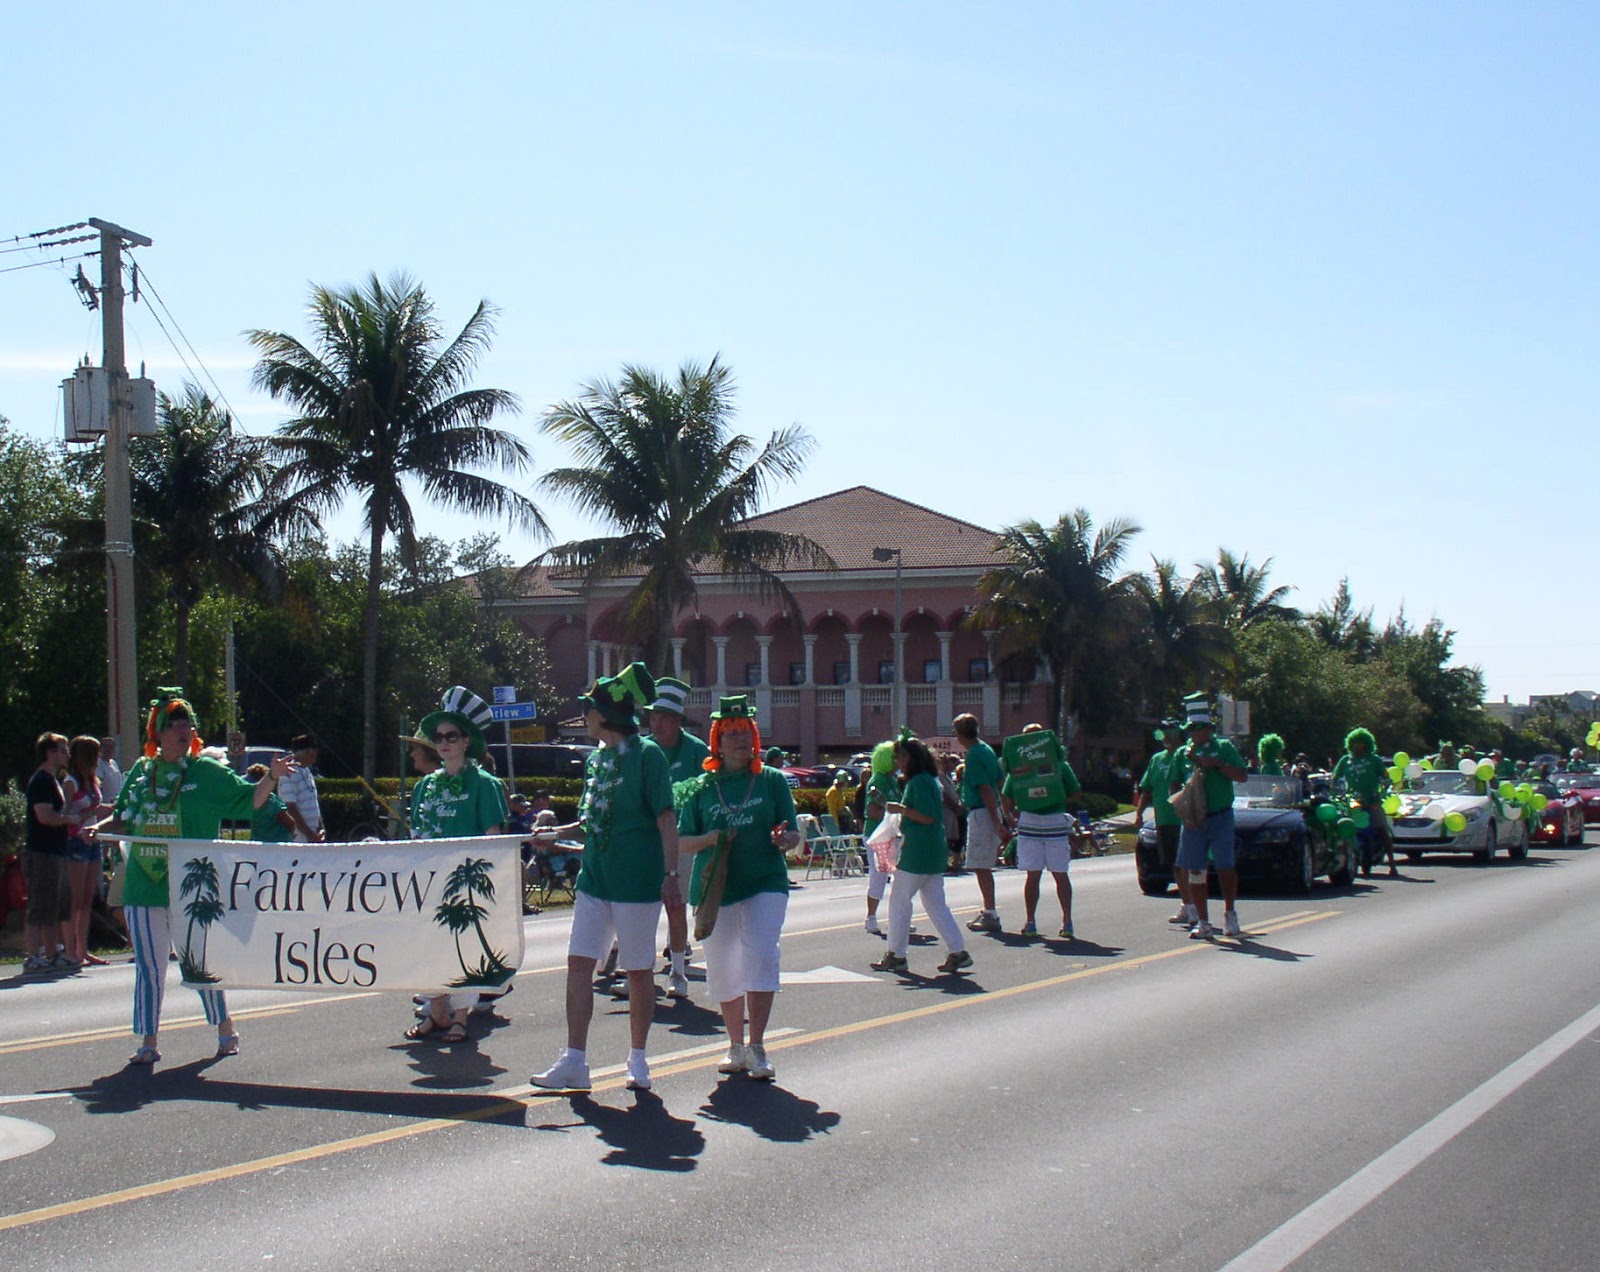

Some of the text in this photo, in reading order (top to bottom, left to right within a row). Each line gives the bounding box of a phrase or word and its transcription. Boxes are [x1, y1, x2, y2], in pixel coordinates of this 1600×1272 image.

[145, 813, 177, 825] EAT
[140, 847, 168, 857] IRIS
[228, 859, 437, 914] Fairview
[274, 927, 377, 987] Isles
